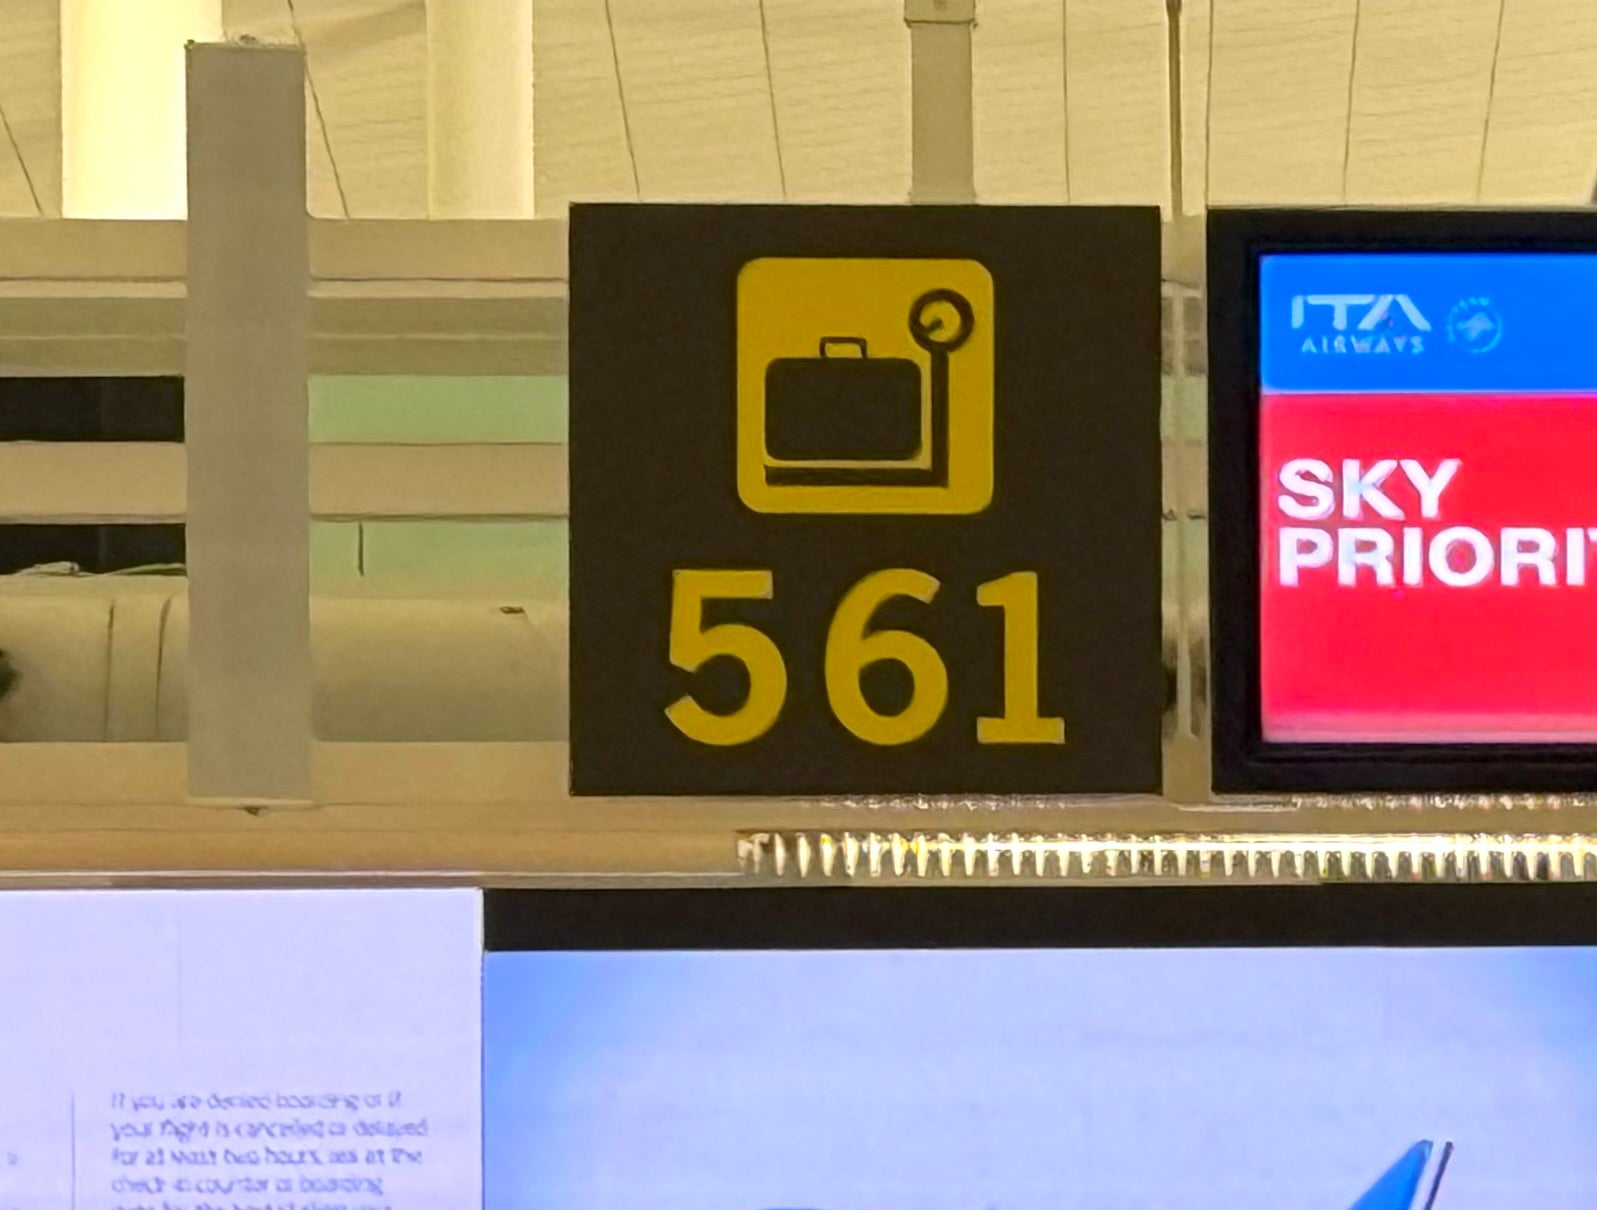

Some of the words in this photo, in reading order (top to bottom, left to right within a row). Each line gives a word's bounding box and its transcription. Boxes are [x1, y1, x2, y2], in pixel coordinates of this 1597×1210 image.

[1290, 293, 1432, 332] ITA
[1301, 336, 1425, 355] AIRWAYS
[1277, 458, 1462, 520] SKY
[664, 567, 1066, 747] 561
